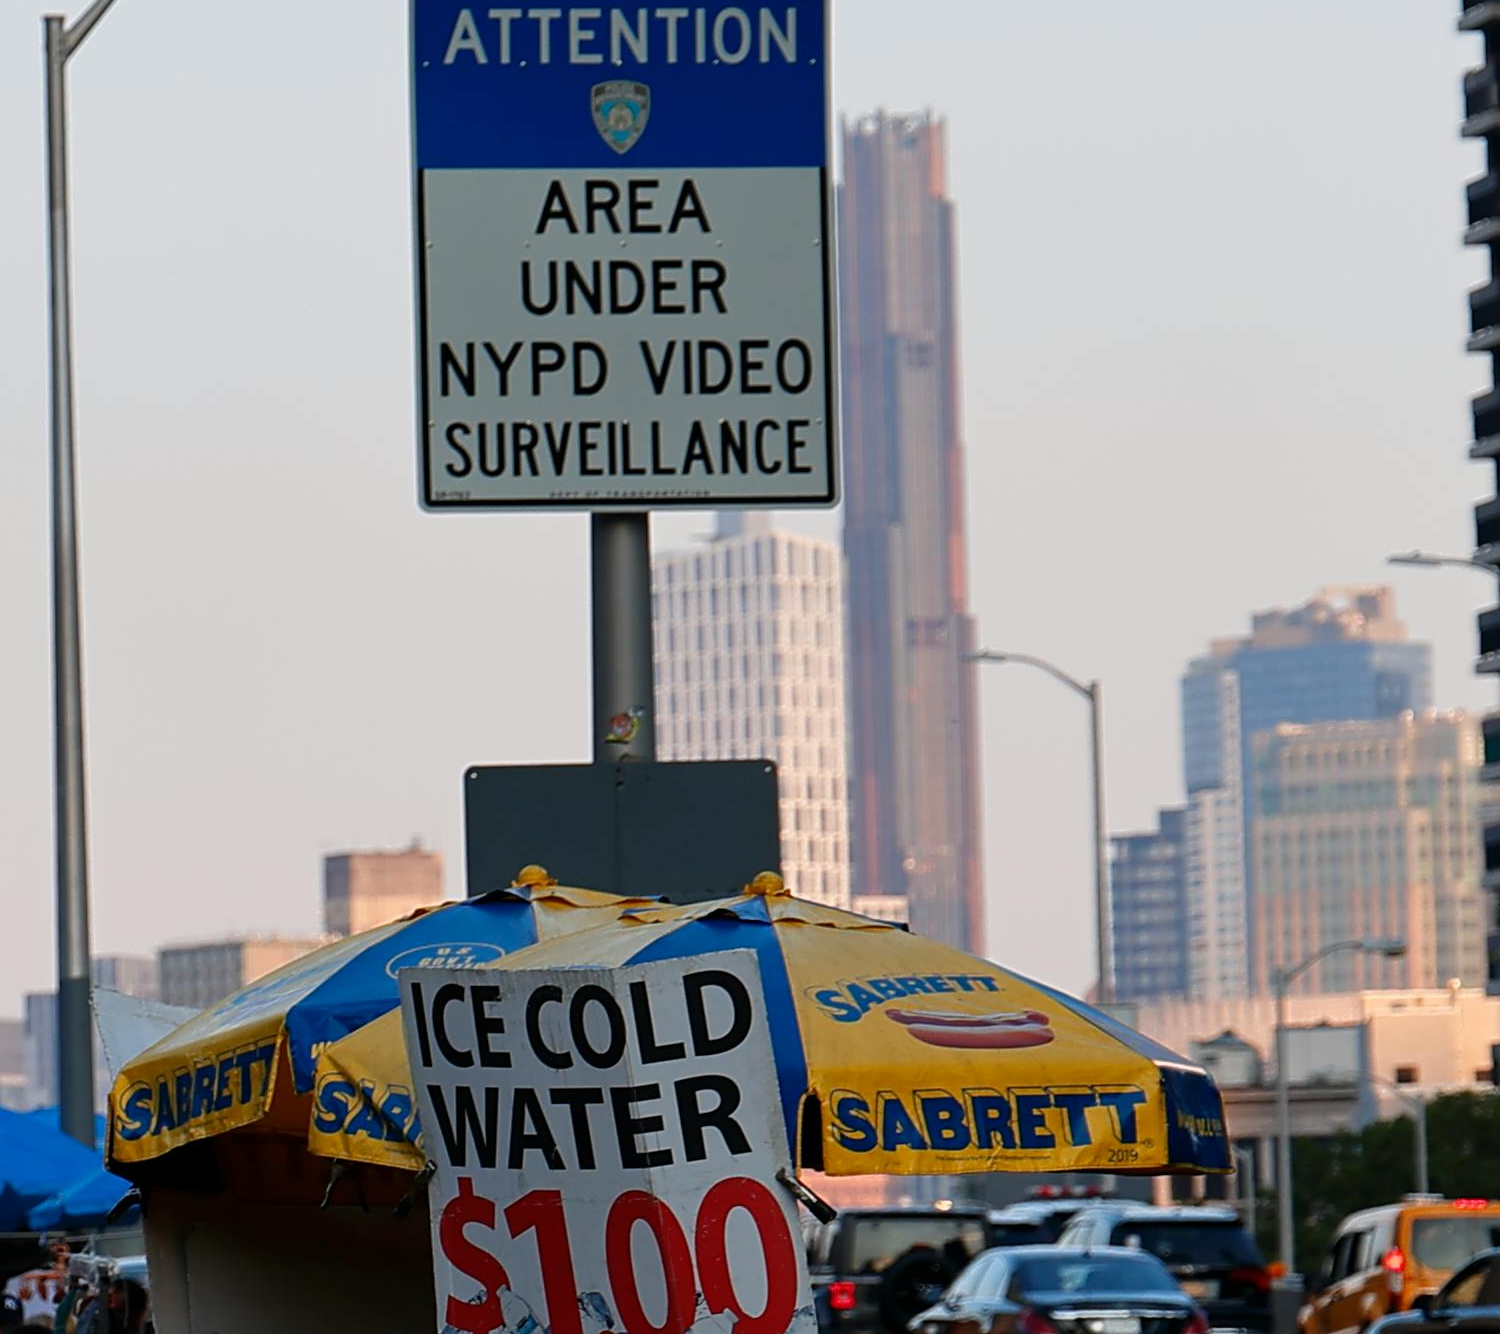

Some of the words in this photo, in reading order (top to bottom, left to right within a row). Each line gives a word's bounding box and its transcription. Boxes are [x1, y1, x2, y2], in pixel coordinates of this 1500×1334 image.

[443, 7, 798, 65] ATTENTION
[535, 178, 712, 235] AREA
[520, 259, 728, 316] UNDER
[439, 341, 609, 397] NYPD
[639, 338, 813, 396] VIDEO
[444, 418, 813, 478] SURVEILLANCE
[411, 981, 512, 1068] ICE
[525, 969, 753, 1070] COLD
[806, 973, 999, 1023] SABRETT
[427, 1074, 753, 1170] WATER
[828, 1085, 1146, 1153] SABRETT
[1107, 1148, 1139, 1163] 2019
